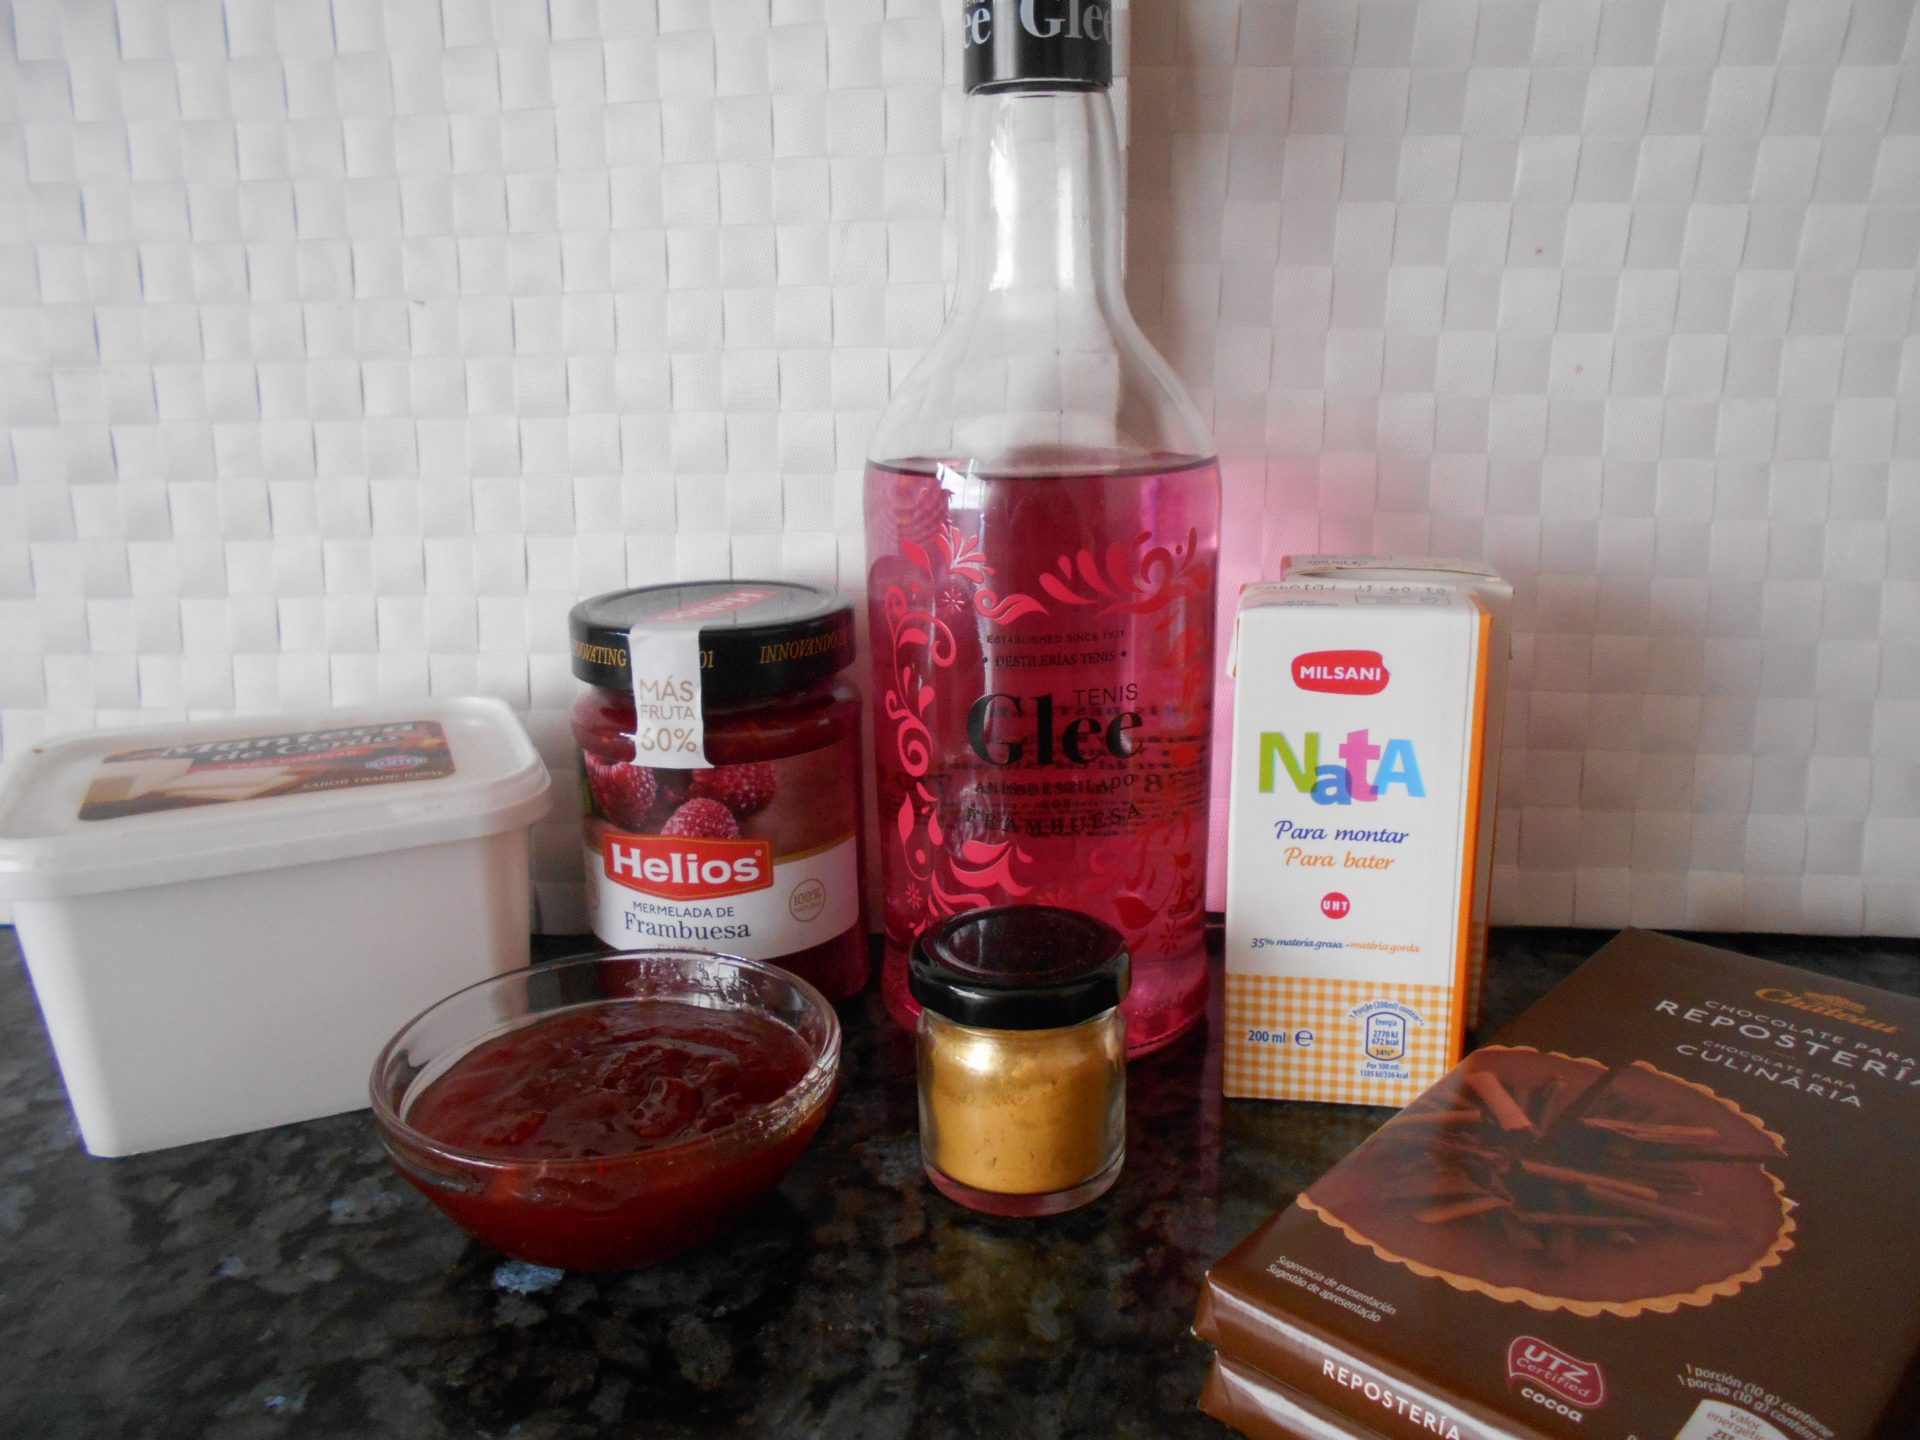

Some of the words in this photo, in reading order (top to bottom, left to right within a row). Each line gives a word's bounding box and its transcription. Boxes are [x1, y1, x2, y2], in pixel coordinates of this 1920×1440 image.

[987, 635, 1062, 645] ESTABLISHED
[1067, 632, 1098, 643] SINCE
[576, 639, 628, 667] OVATING
[1080, 650, 1116, 664] TENIS
[1300, 666, 1381, 681] MILSANI
[639, 675, 694, 702] MÁS
[1073, 683, 1138, 706] TENIS
[640, 705, 696, 720] FRUTA
[967, 692, 1143, 766] Glee
[1274, 820, 1327, 840] Para
[1334, 829, 1410, 844] montar
[611, 843, 760, 884] Helios
[1283, 847, 1336, 867] Para
[1344, 851, 1396, 871] bater
[633, 901, 713, 918] MERMELADA
[716, 906, 735, 917] DE
[1322, 900, 1348, 911] UHT
[624, 911, 752, 940] Frambuesa
[1250, 937, 1275, 949] 35%
[1315, 941, 1344, 951] grasa
[1389, 942, 1421, 954] gorda
[1248, 1030, 1269, 1043] 200
[1272, 1032, 1286, 1043] ml
[1705, 1000, 1846, 1045] CHOCOLATE
[1854, 1042, 1915, 1067] PARA
[1676, 1044, 1862, 1108] CULINÁRIA
[1703, 1039, 1804, 1075] CHOCOLATE
[1811, 1072, 1856, 1090] PARA
[1266, 1263, 1307, 1288] Sugestão
[1306, 1280, 1319, 1294] de
[1318, 1287, 1382, 1323] apresentação
[1276, 1255, 1325, 1283] Sugerencia
[1324, 1275, 1337, 1287] de
[1337, 1282, 1397, 1316] presentación
[1516, 1357, 1591, 1398] Certified
[1524, 1345, 1589, 1383] UTZ
[1322, 1359, 1460, 1440] REPOSTERÍA
[1521, 1387, 1584, 1422] cocoa
[1677, 1374, 1685, 1386] 1
[1687, 1378, 1730, 1397] porção
[1733, 1390, 1753, 1404] (10
[1753, 1401, 1770, 1414] g)
[1685, 1363, 1693, 1375] 1
[1694, 1367, 1742, 1389] porción
[1744, 1383, 1764, 1397] (10
[1764, 1393, 1781, 1407] g)
[1781, 1402, 1835, 1439] contiene
[1729, 1409, 1761, 1430] Valor
